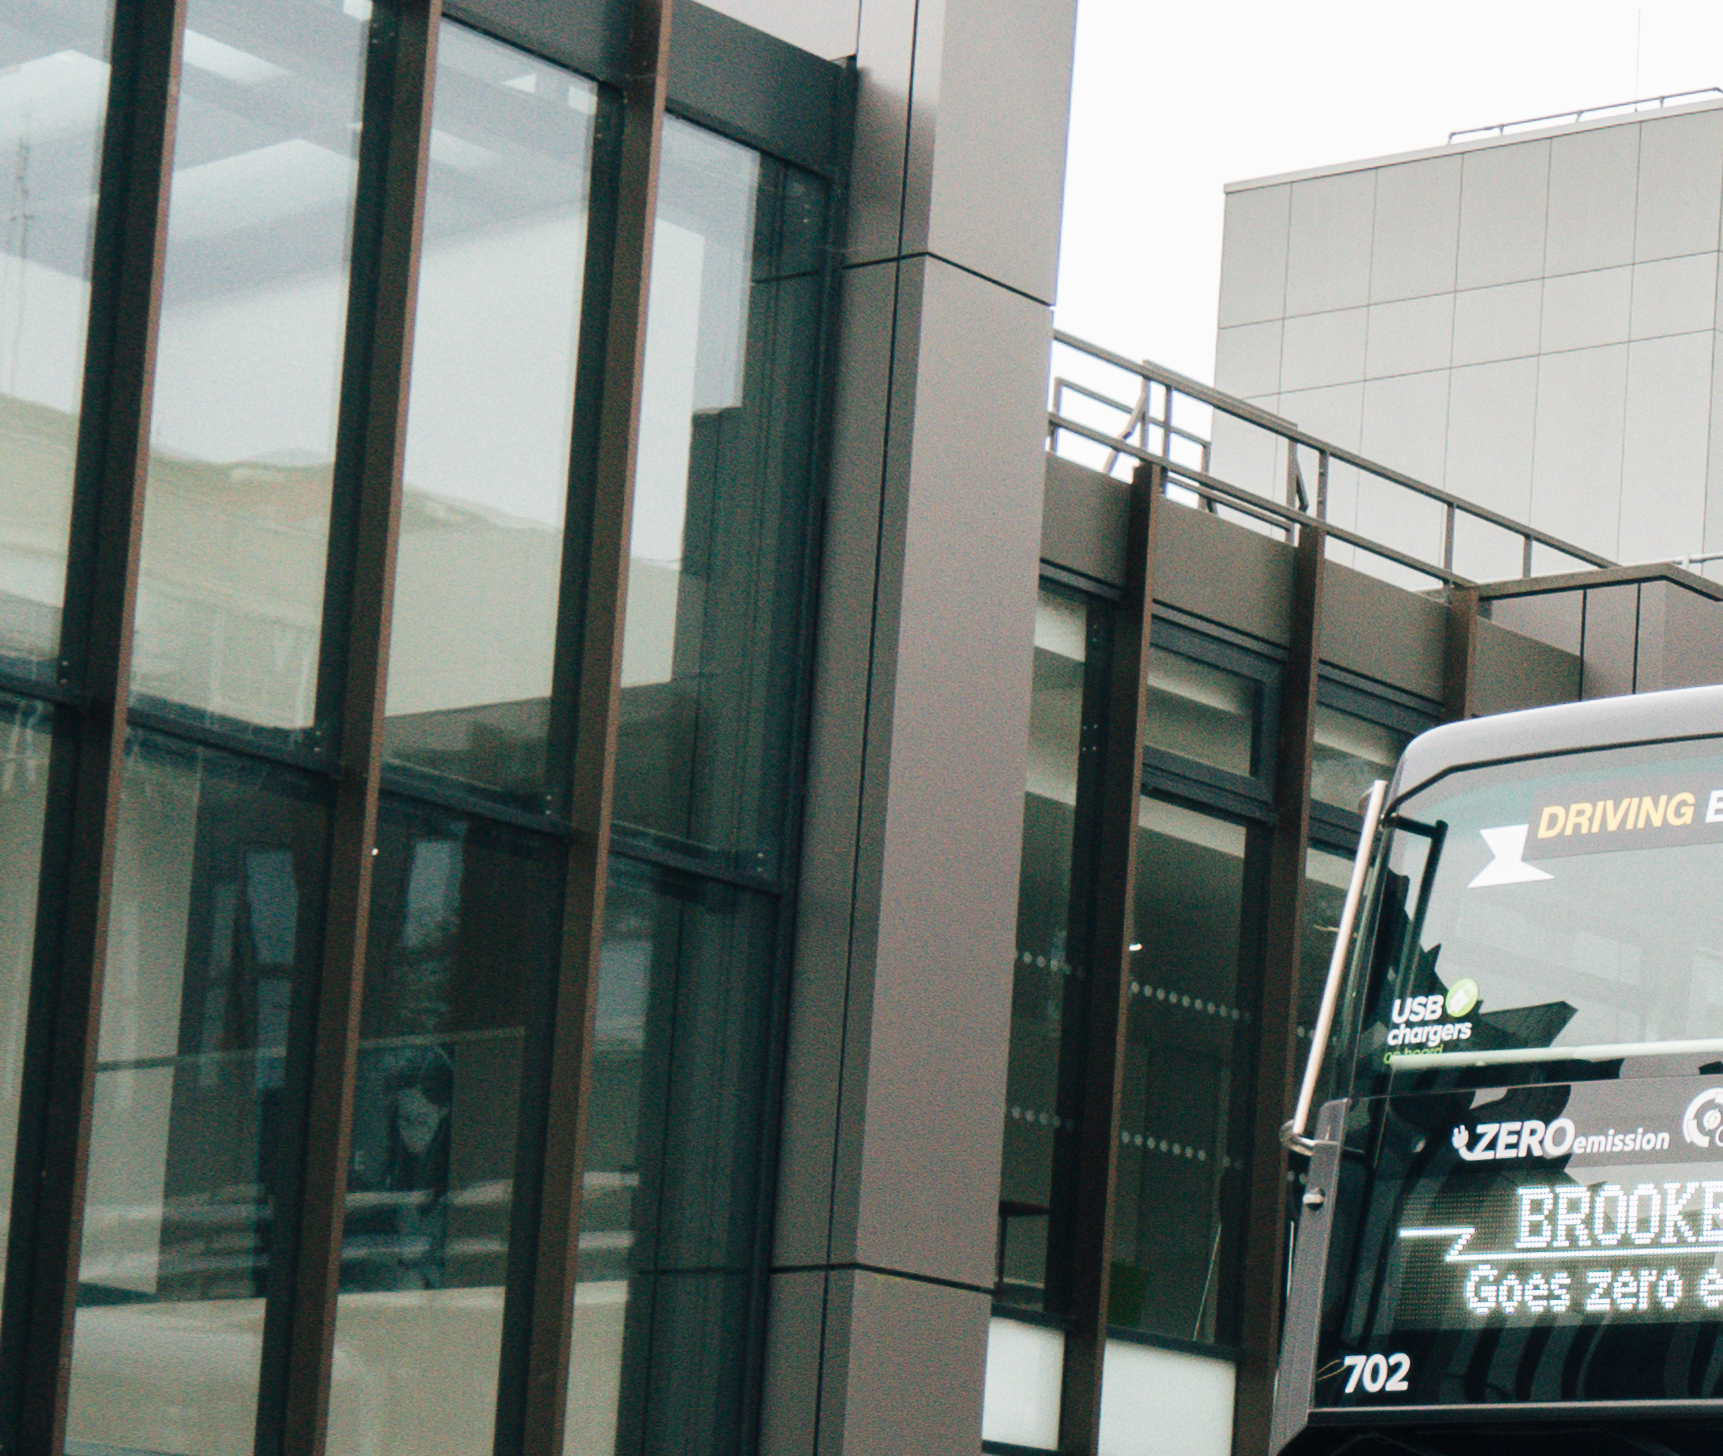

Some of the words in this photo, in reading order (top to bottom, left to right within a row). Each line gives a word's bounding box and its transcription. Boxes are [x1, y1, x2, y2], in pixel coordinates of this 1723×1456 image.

[1537, 792, 1695, 839] DRIVING
[1391, 994, 1444, 1024] USB
[1387, 1022, 1472, 1047] chargers
[1463, 1264, 1572, 1315] Goes
[1585, 1267, 1683, 1311] zero
[1344, 1352, 1410, 1393] 702
